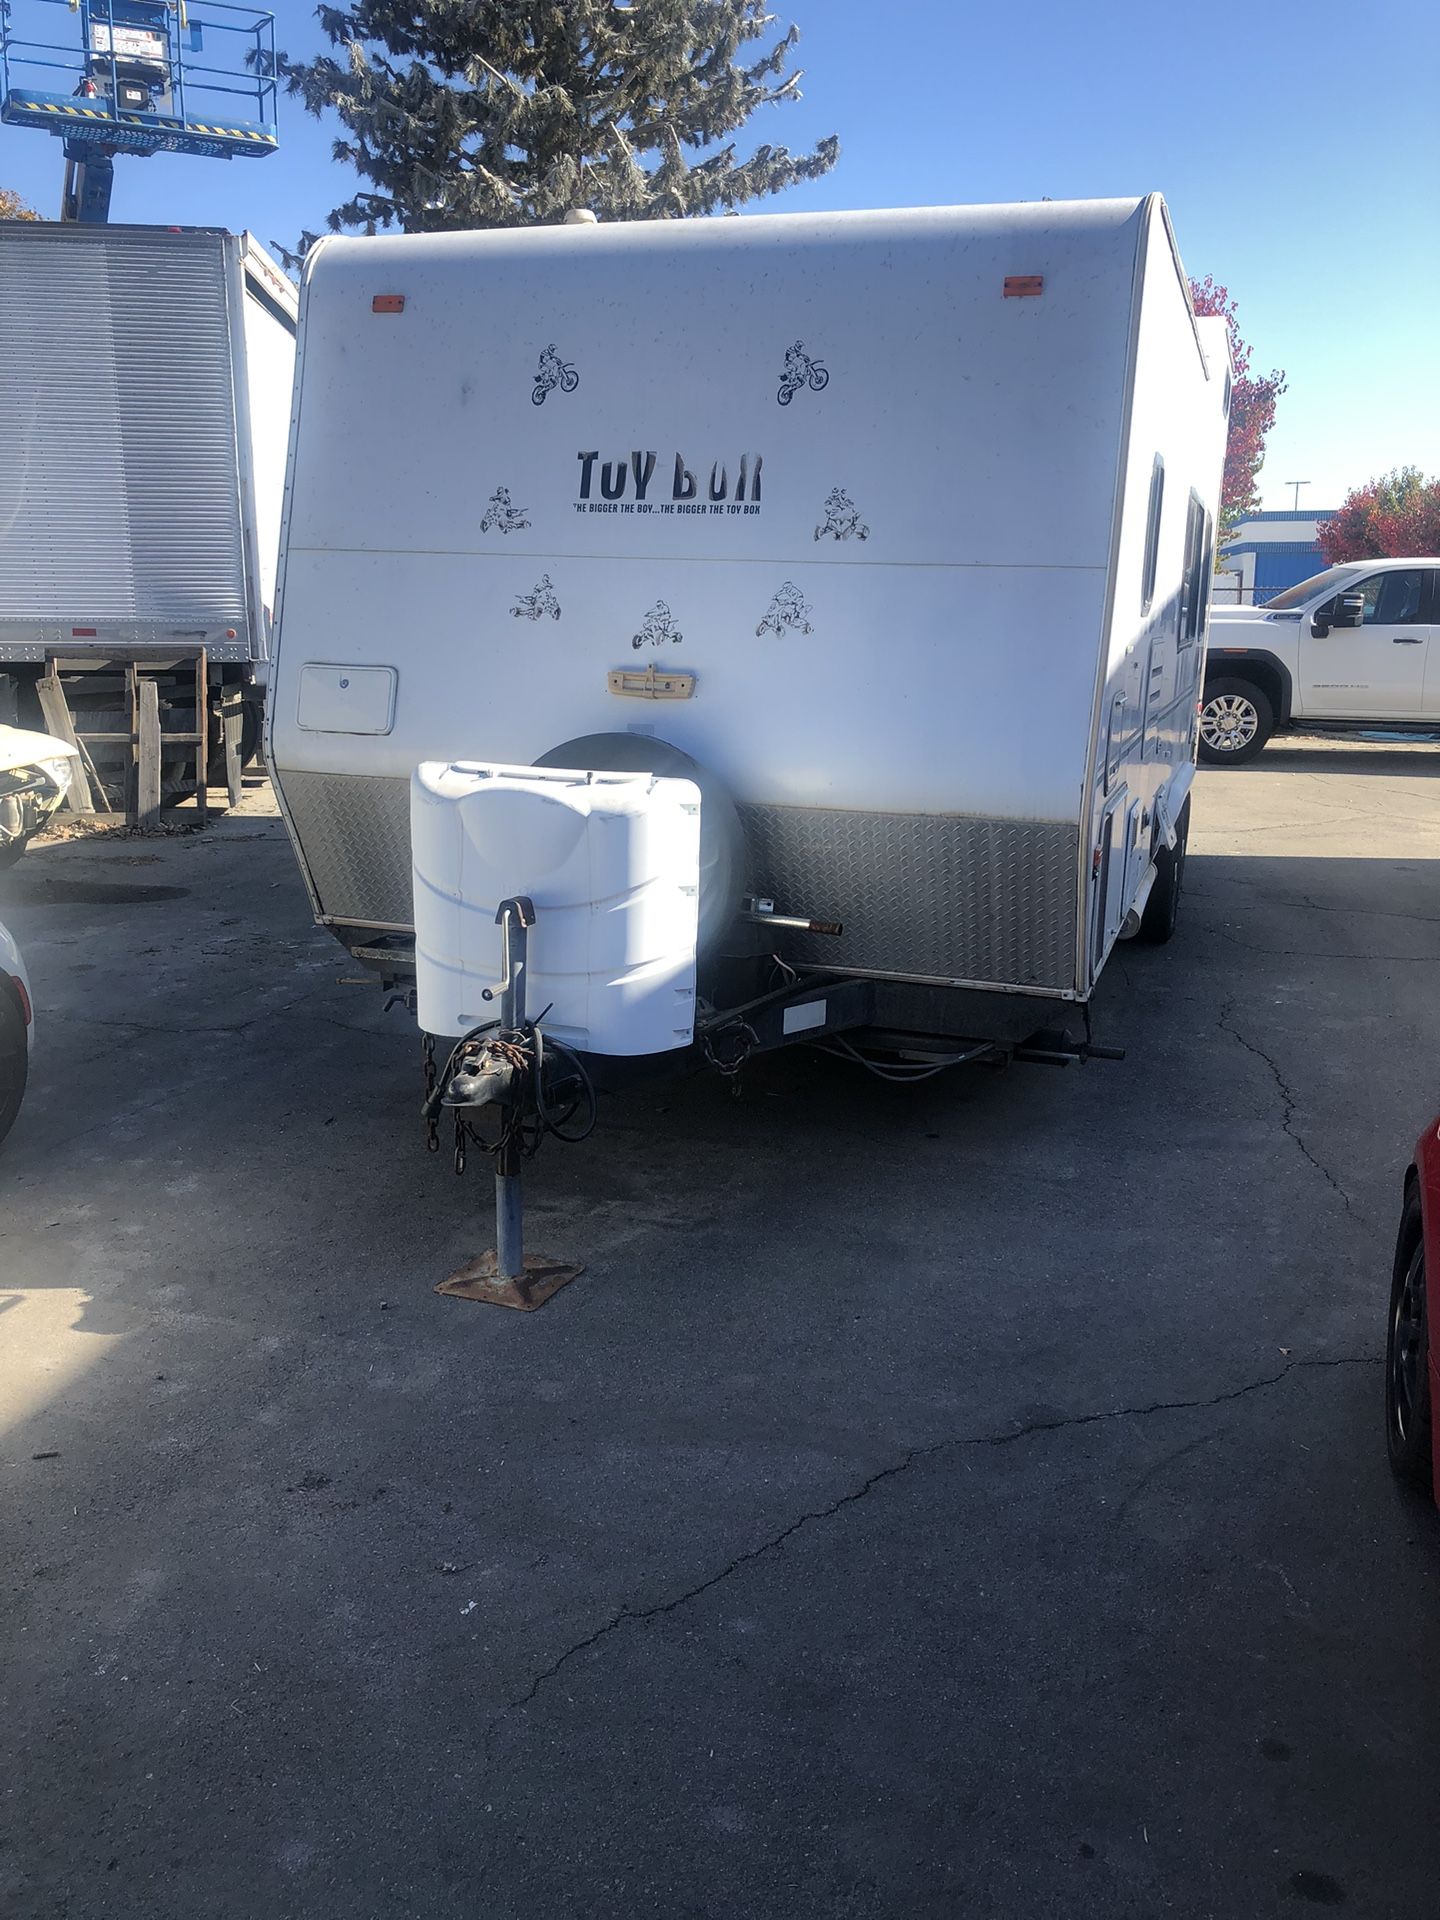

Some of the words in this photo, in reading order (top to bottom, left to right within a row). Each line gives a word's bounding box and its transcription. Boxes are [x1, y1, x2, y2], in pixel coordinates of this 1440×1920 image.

[589, 503, 618, 513] BIGGER
[620, 504, 635, 513] THE
[677, 504, 706, 514] BIGGER
[709, 505, 724, 514] THE
[726, 505, 741, 514] TOY
[743, 505, 760, 514] BOX
